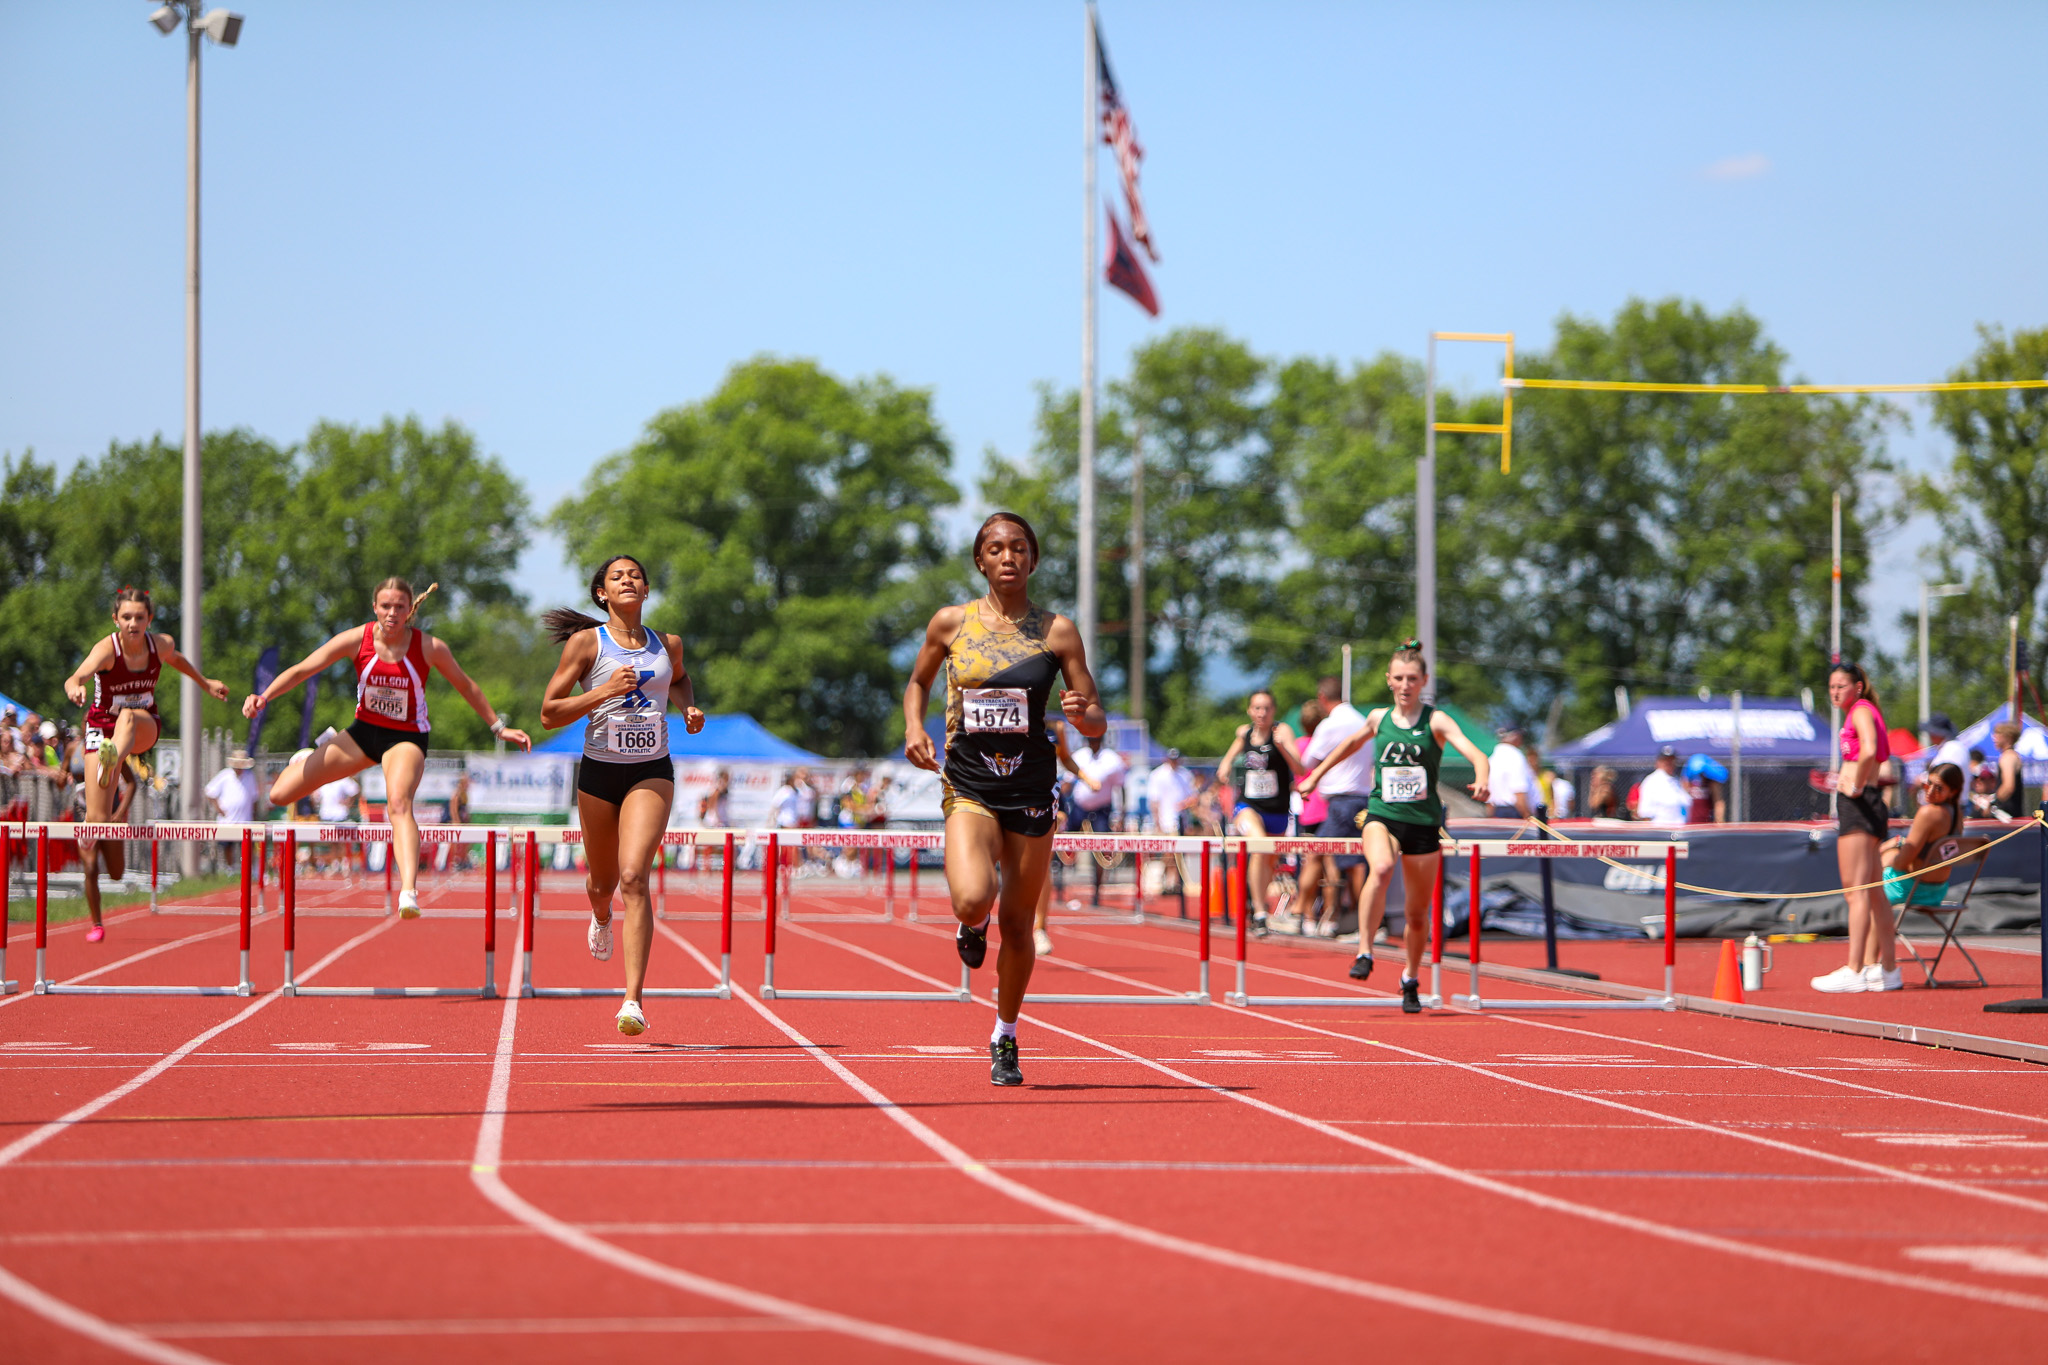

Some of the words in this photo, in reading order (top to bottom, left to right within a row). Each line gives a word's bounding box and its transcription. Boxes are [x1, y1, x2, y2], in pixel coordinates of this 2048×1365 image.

[109, 679, 157, 692] POTTSVILL
[370, 675, 409, 688] WILSON
[621, 670, 655, 708] K
[370, 698, 402, 714] 2095
[972, 707, 1021, 727] 1574
[615, 731, 656, 748] 1668
[1390, 782, 1421, 796] 1892
[74, 826, 153, 840] SHIPPENSBURG
[156, 827, 217, 840] UNIVERSITY
[319, 829, 393, 842] SHIPPENSBUR
[420, 830, 462, 843] VERSITY
[663, 832, 697, 845] ERSITY
[802, 833, 878, 847] SHIPPENSBURG
[882, 834, 941, 848] UNIVERSITY
[1053, 838, 1115, 851] IPPENSBURG
[1118, 839, 1178, 852] UNIVERSITY
[1273, 841, 1346, 855] SHIPPENSBURG
[1506, 844, 1579, 857] SHIPPENSBURG
[1582, 845, 1640, 858] UNIVERSITY
